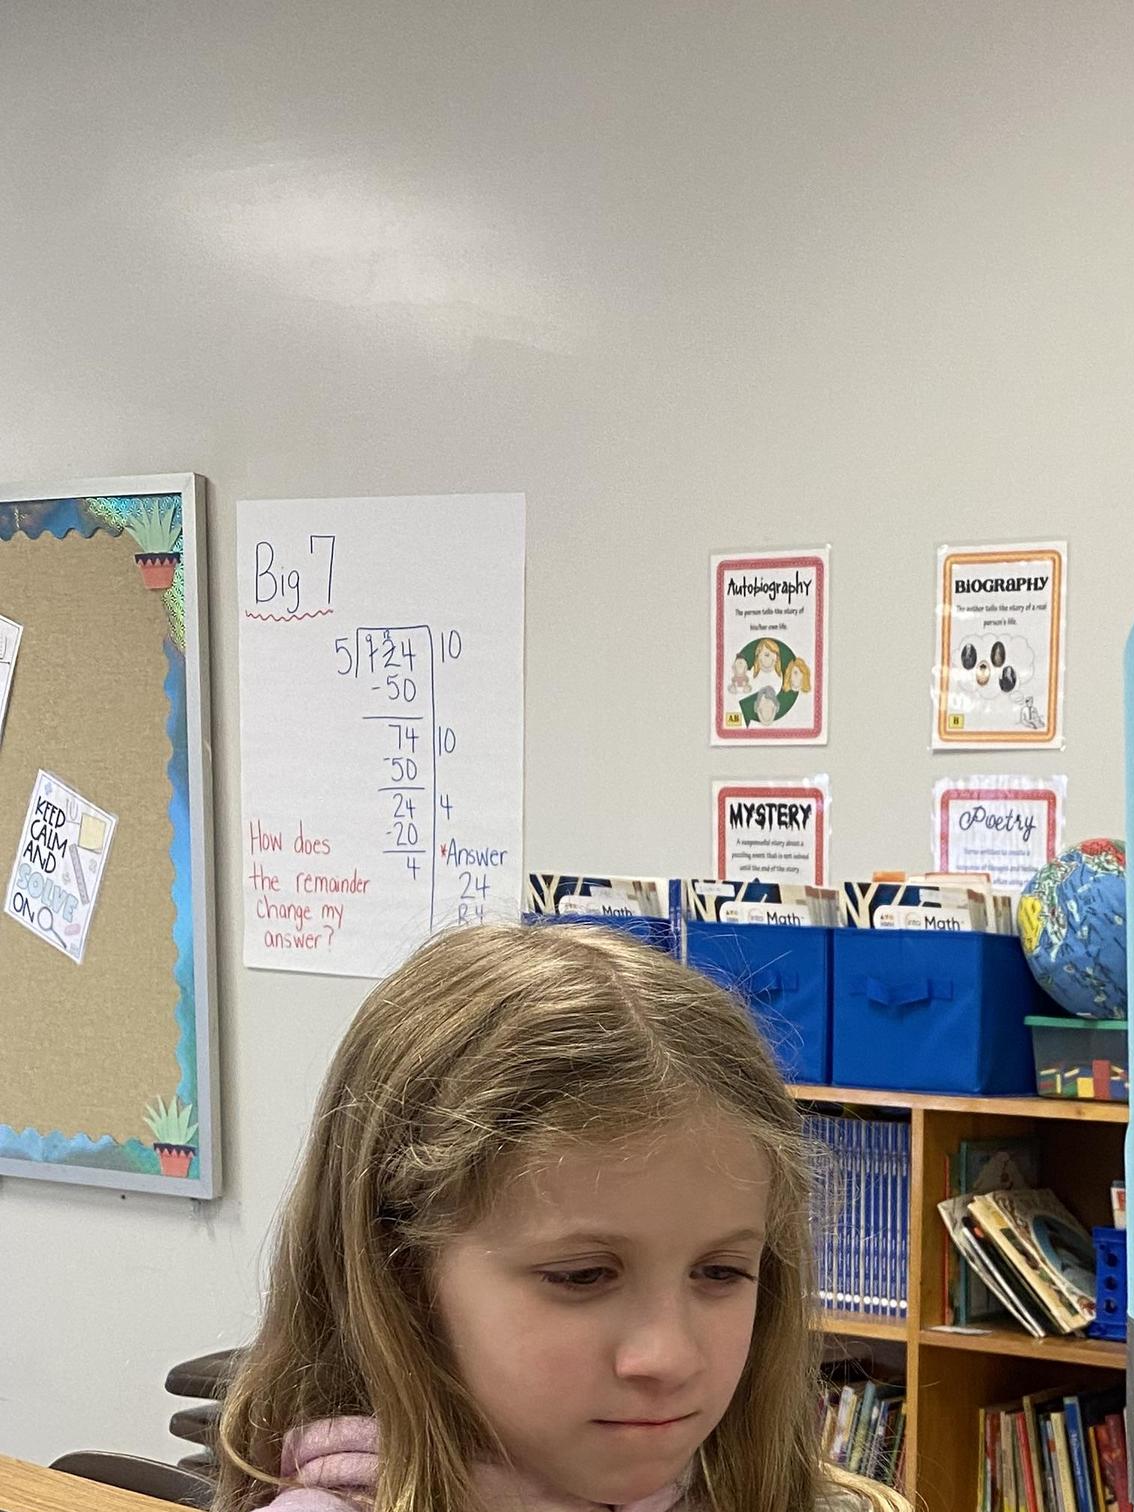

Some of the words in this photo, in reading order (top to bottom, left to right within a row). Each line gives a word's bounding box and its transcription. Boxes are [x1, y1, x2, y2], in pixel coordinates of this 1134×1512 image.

[254, 540, 300, 614] Big
[309, 534, 336, 605] 7
[727, 570, 813, 605] Autobiography
[335, 637, 353, 675] 5
[440, 629, 463, 664] 10
[388, 723, 419, 754] 74
[438, 726, 457, 757] 10
[392, 792, 416, 820] 24
[440, 793, 453, 821] 4
[729, 802, 812, 832] MYSTERY
[30, 819, 68, 859] CALM
[249, 818, 282, 856] How
[294, 818, 331, 856] does
[959, 805, 1037, 843] Poetry
[23, 839, 57, 874] AND
[406, 856, 420, 882] 4
[16, 862, 80, 923] SOLVE
[249, 861, 281, 894] the
[295, 867, 371, 895] remainder
[458, 871, 491, 901] 24
[13, 892, 35, 924] ON
[320, 902, 344, 930] my
[766, 911, 801, 925] Math
[924, 915, 960, 931] Math
